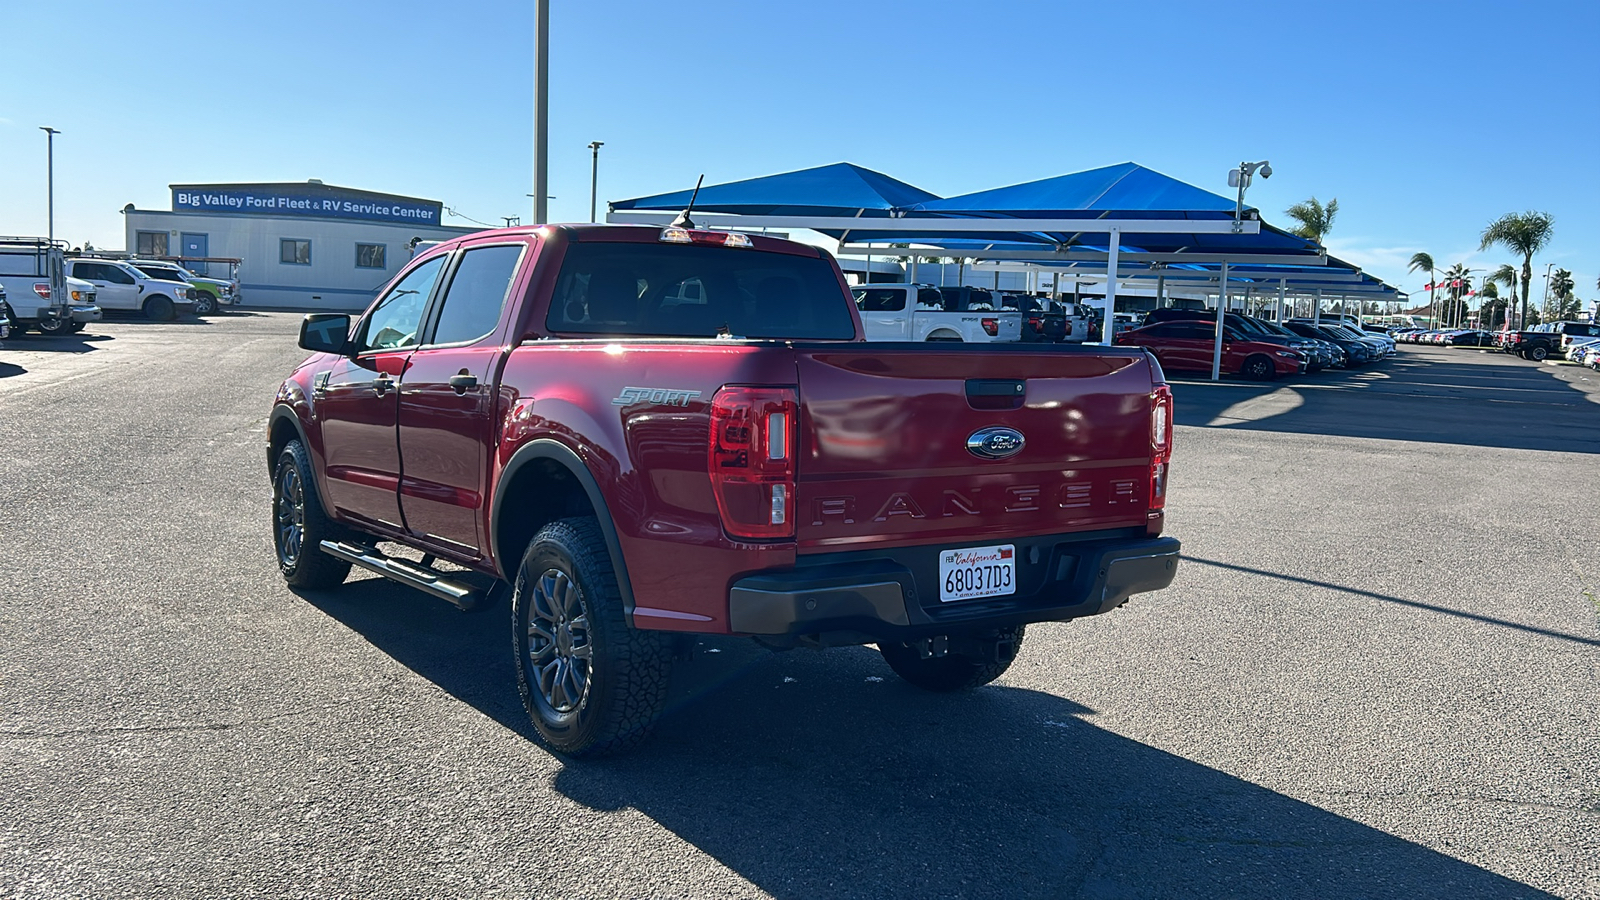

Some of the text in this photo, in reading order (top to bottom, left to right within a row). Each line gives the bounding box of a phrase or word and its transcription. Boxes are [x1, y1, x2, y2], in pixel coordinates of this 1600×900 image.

[178, 193, 433, 219] Big Valley Ford Fleet & RV Service Center
[611, 386, 702, 407] SPORT
[991, 435, 1016, 449] Ford
[811, 479, 1139, 526] RANGER
[955, 552, 1001, 567] California
[945, 564, 1011, 593] 68037D3
